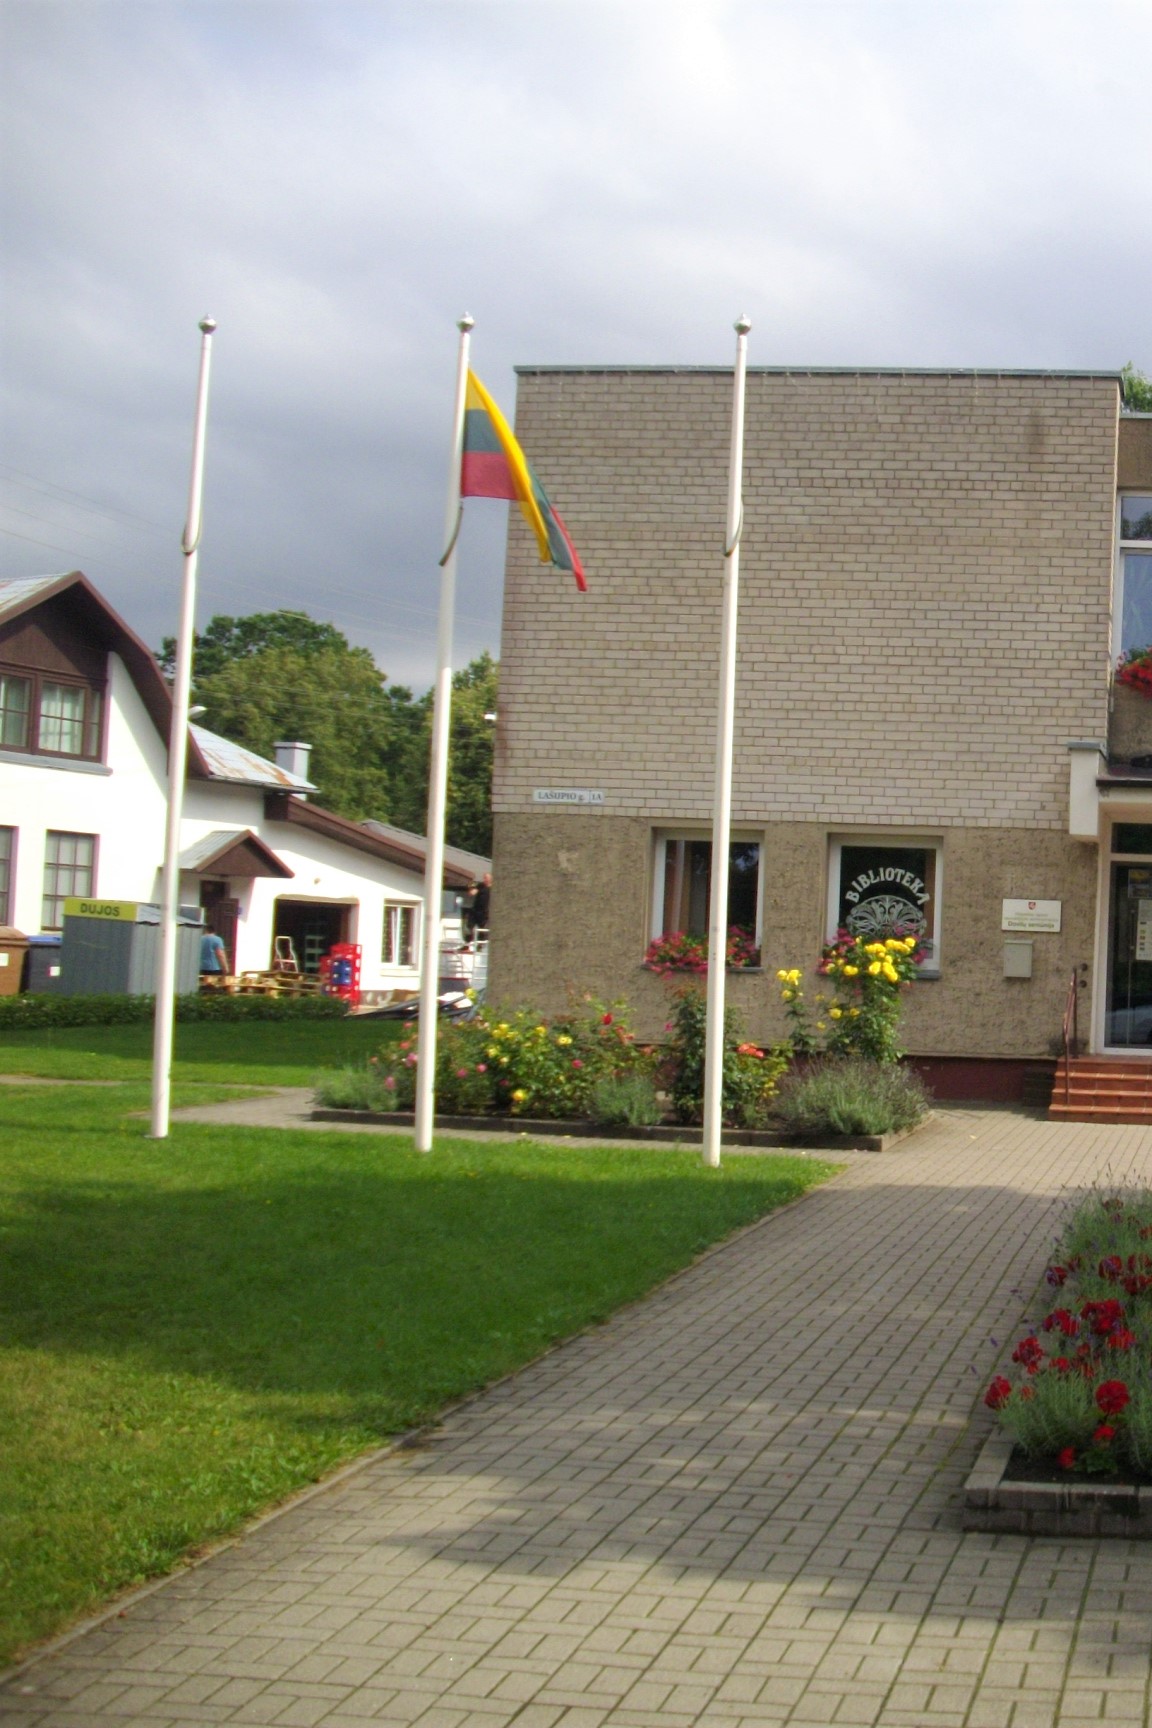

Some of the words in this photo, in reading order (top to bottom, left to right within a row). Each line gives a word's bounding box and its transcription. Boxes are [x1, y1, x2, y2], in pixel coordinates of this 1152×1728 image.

[538, 790, 577, 800] LAŠUPIO
[845, 867, 930, 905] BIBLIOTEKA
[80, 903, 120, 917] DUJOS
